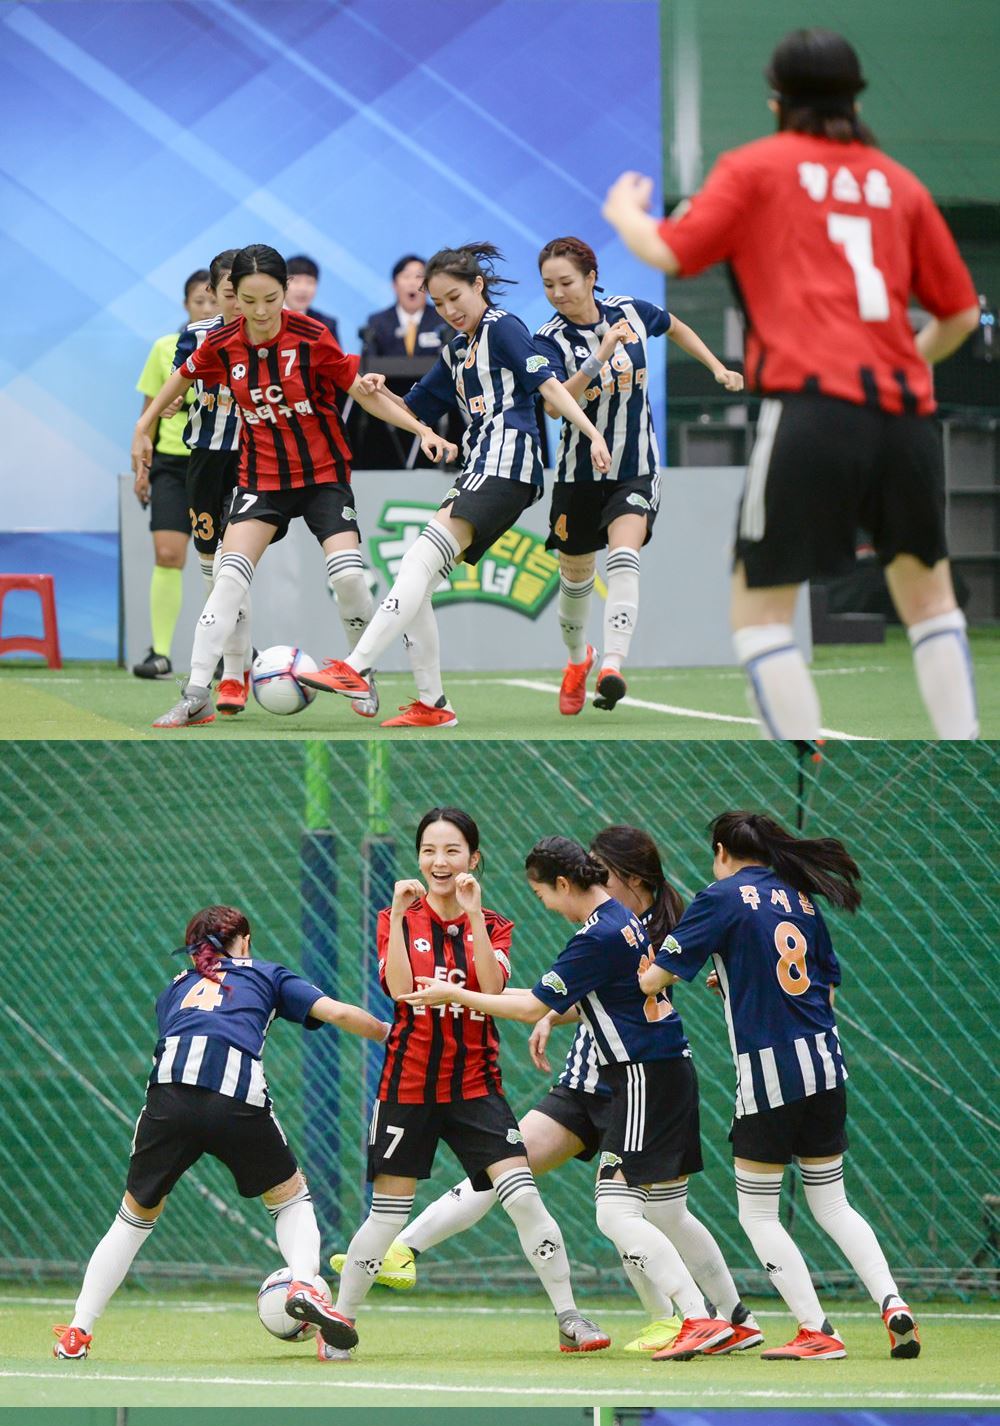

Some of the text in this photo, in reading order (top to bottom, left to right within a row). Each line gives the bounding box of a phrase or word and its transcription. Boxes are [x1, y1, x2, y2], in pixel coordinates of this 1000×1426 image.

[827, 211, 890, 322] 1
[280, 349, 297, 377] 7
[250, 385, 283, 404] FC
[237, 493, 258, 514] 7
[554, 513, 569, 541] 4
[774, 921, 811, 996] 8
[180, 970, 227, 1011] 4
[383, 1125, 405, 1159] 7
